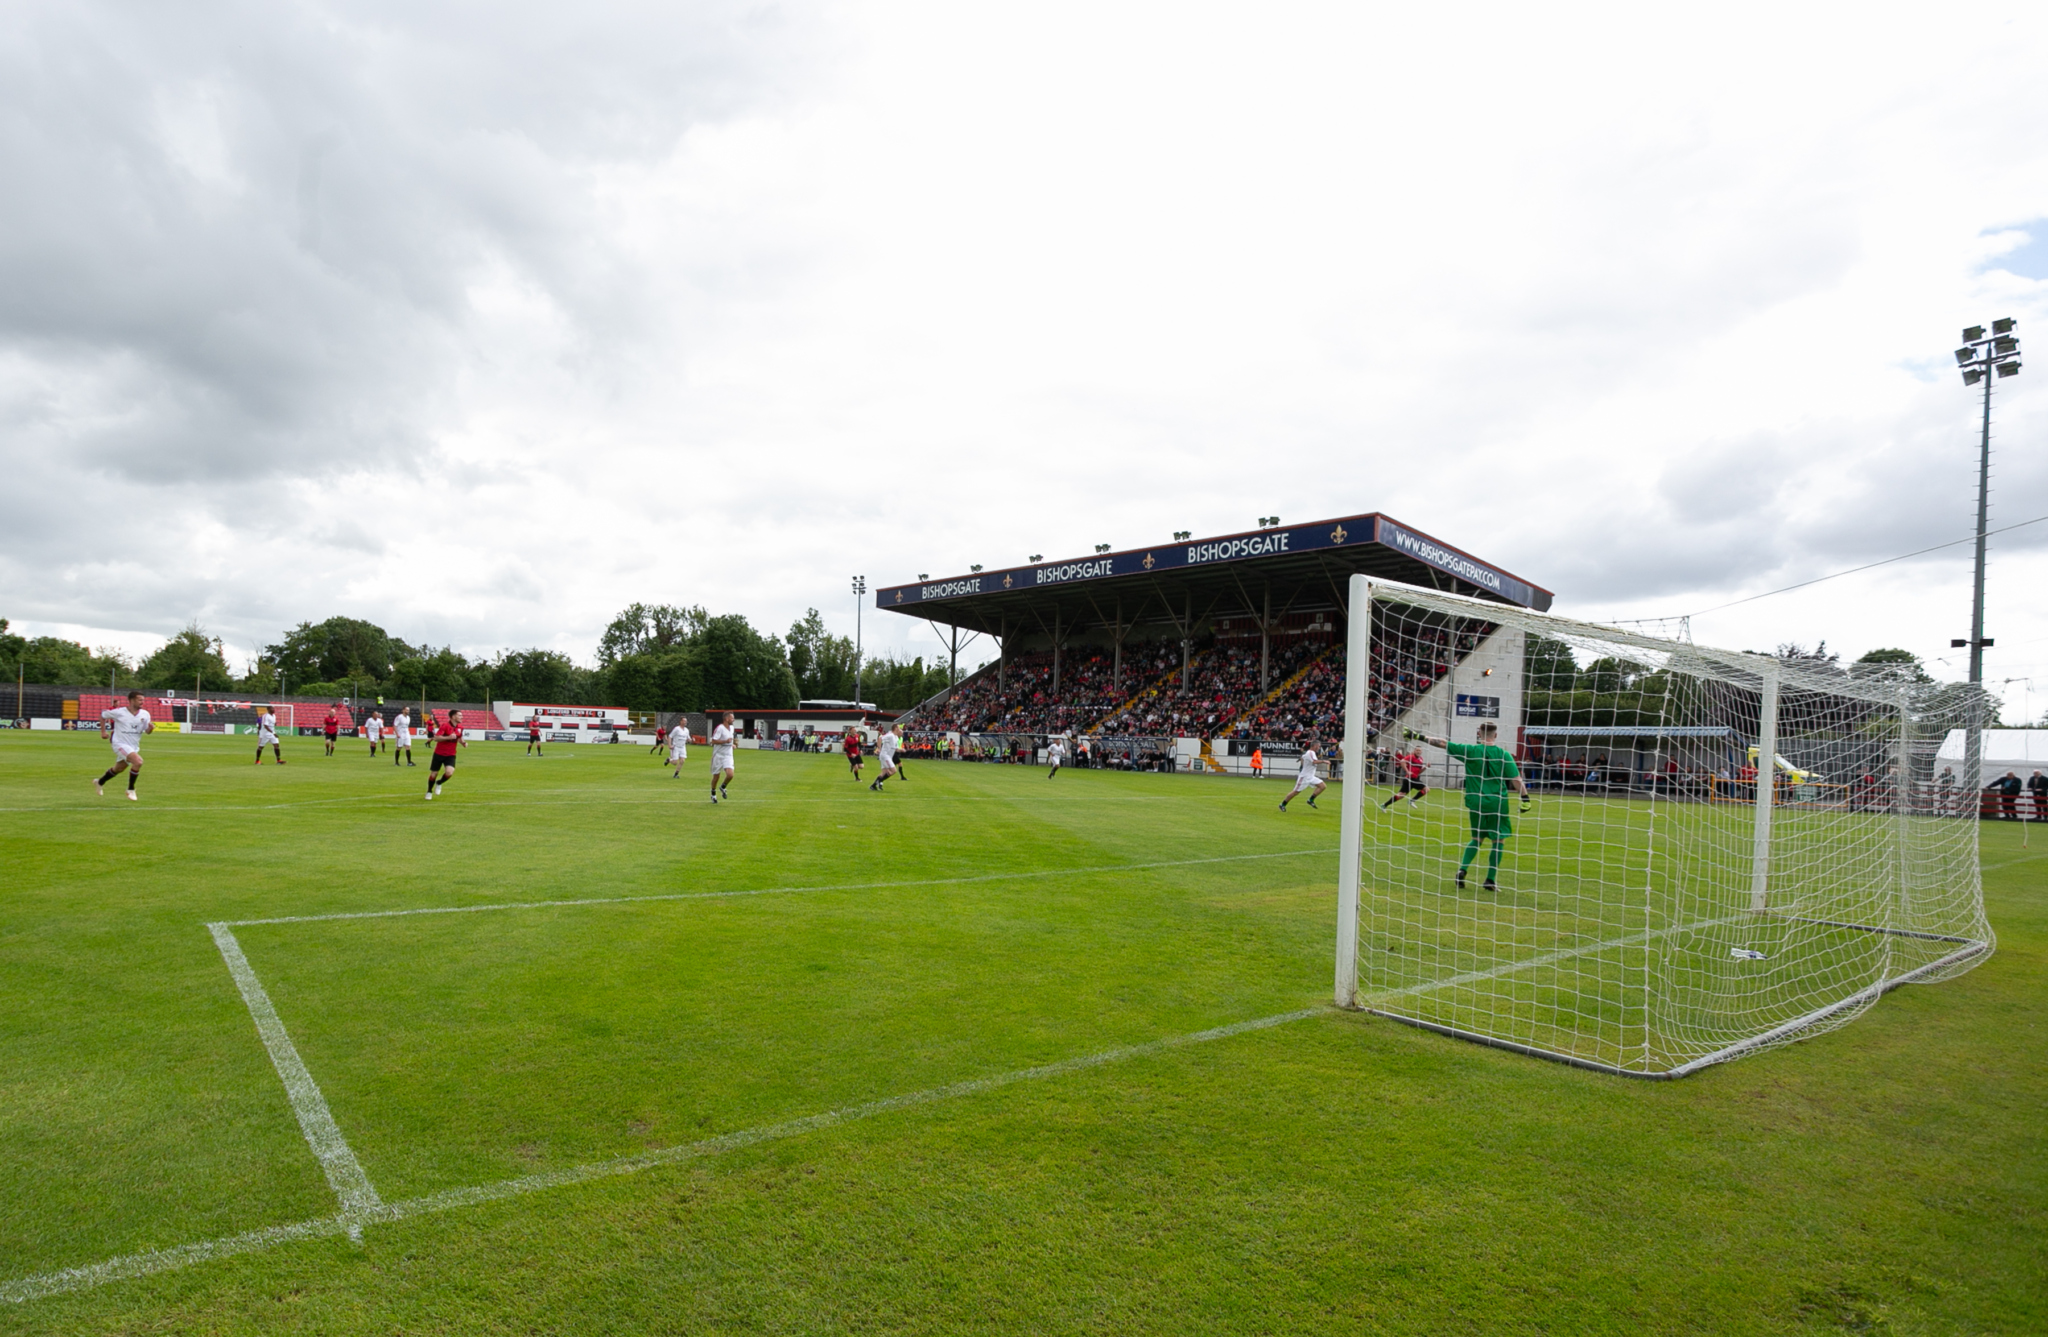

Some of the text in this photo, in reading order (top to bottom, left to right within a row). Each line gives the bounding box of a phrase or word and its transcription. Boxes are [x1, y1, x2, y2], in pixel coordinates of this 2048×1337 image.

[1187, 533, 1290, 563] BISHOPSGATE
[1395, 530, 1500, 590] WWW.BISHOPSGATEPAY.COM
[1036, 559, 1113, 584] BISHOPSGATE
[922, 578, 981, 600] BISHOPSGATE
